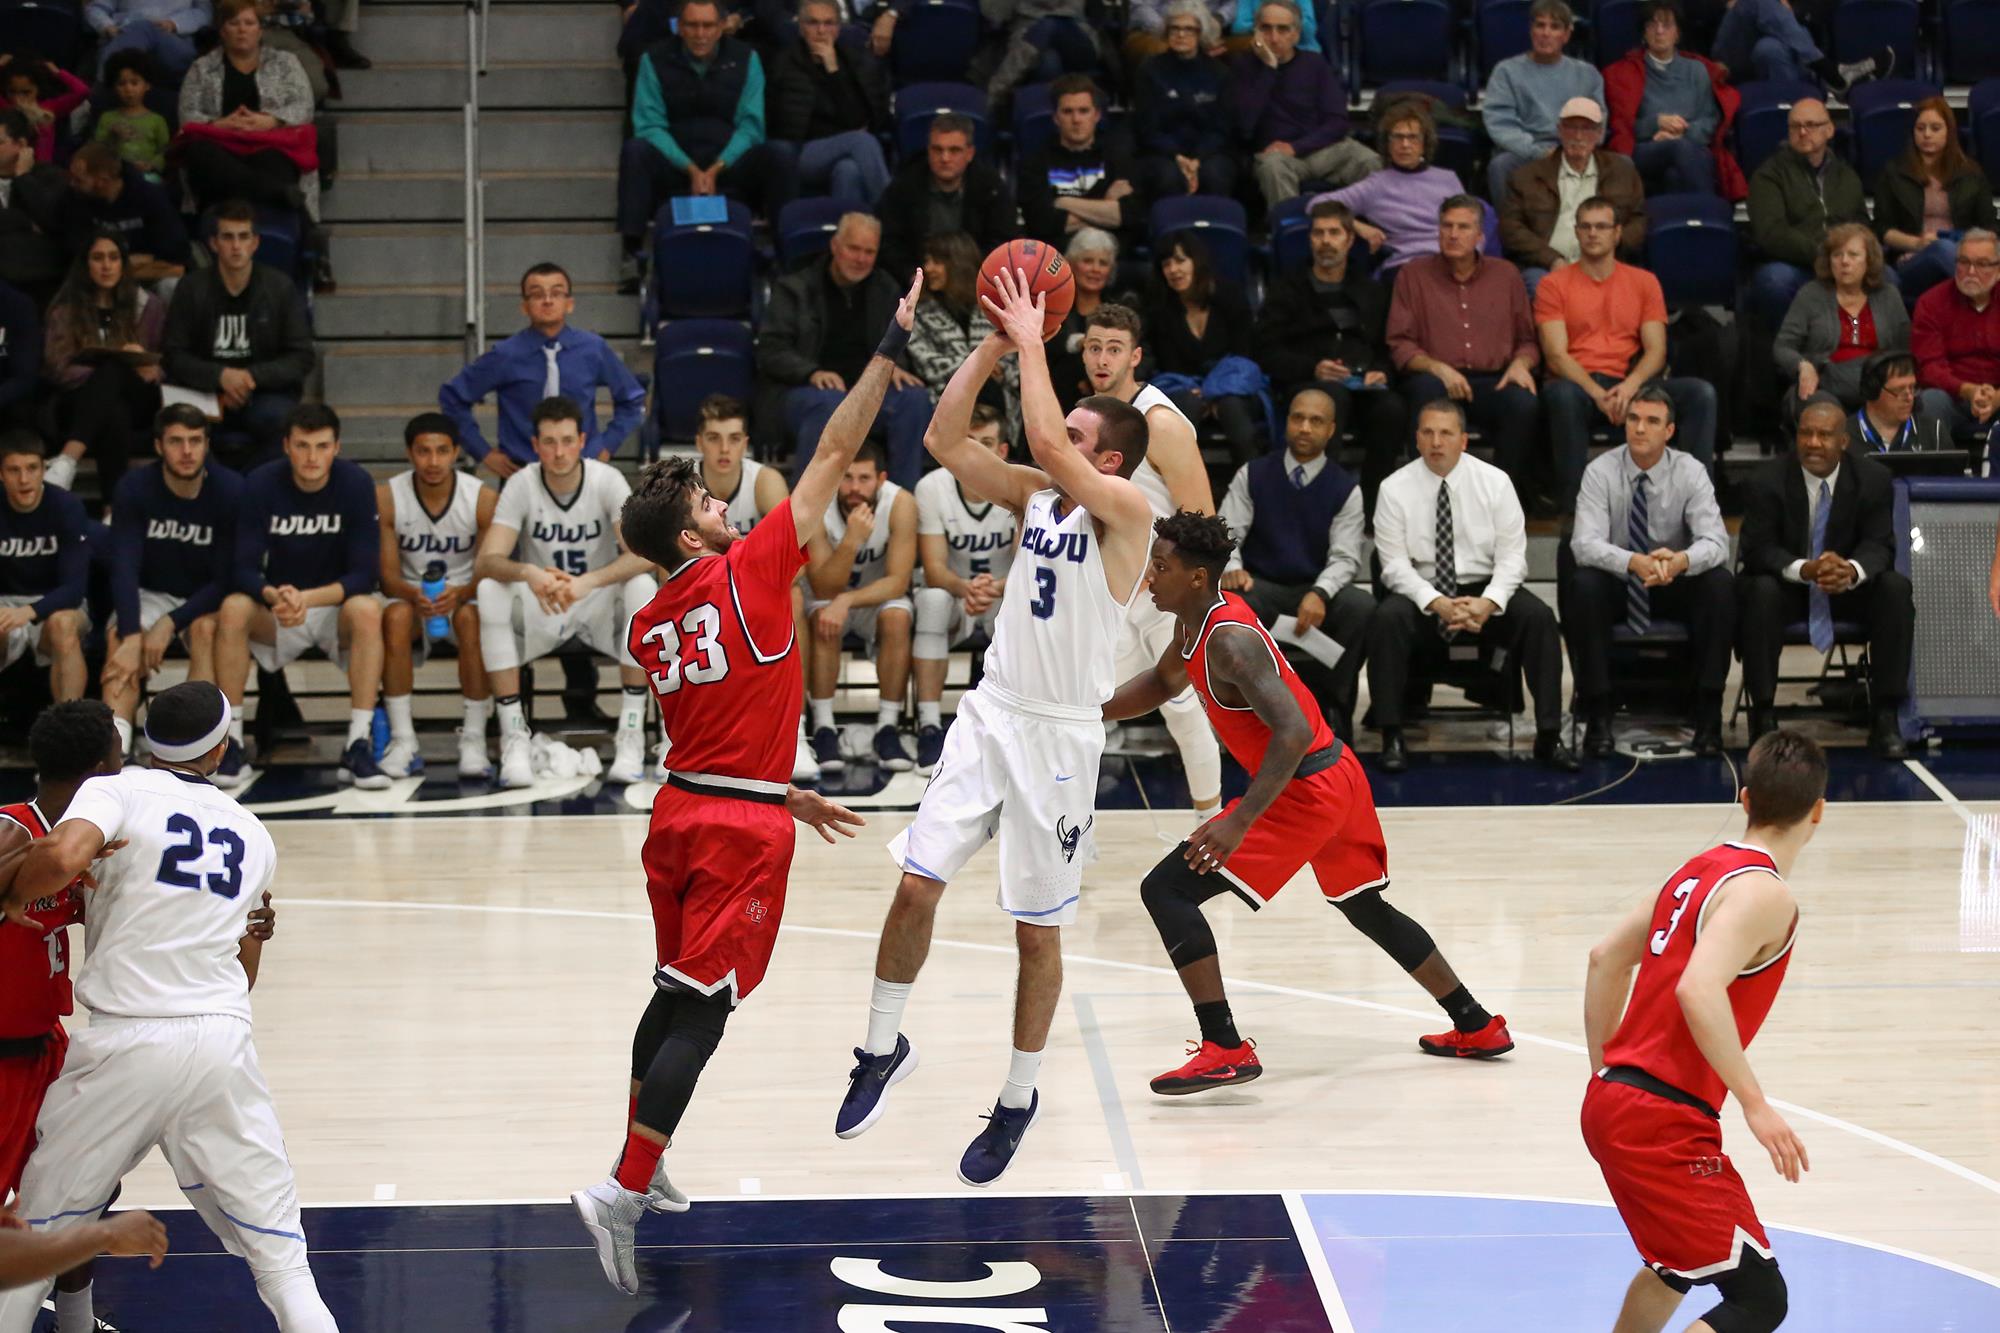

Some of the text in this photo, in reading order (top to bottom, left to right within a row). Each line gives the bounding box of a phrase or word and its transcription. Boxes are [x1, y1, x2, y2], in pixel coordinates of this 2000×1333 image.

[147, 519, 213, 546] WWU
[270, 514, 341, 536] WWU
[532, 520, 601, 543] WWU
[399, 533, 476, 553] WWU
[553, 550, 588, 577] 15
[1030, 566, 1057, 620] 3
[641, 602, 729, 696] 33
[155, 812, 245, 900] 23
[1649, 877, 1701, 956] 3
